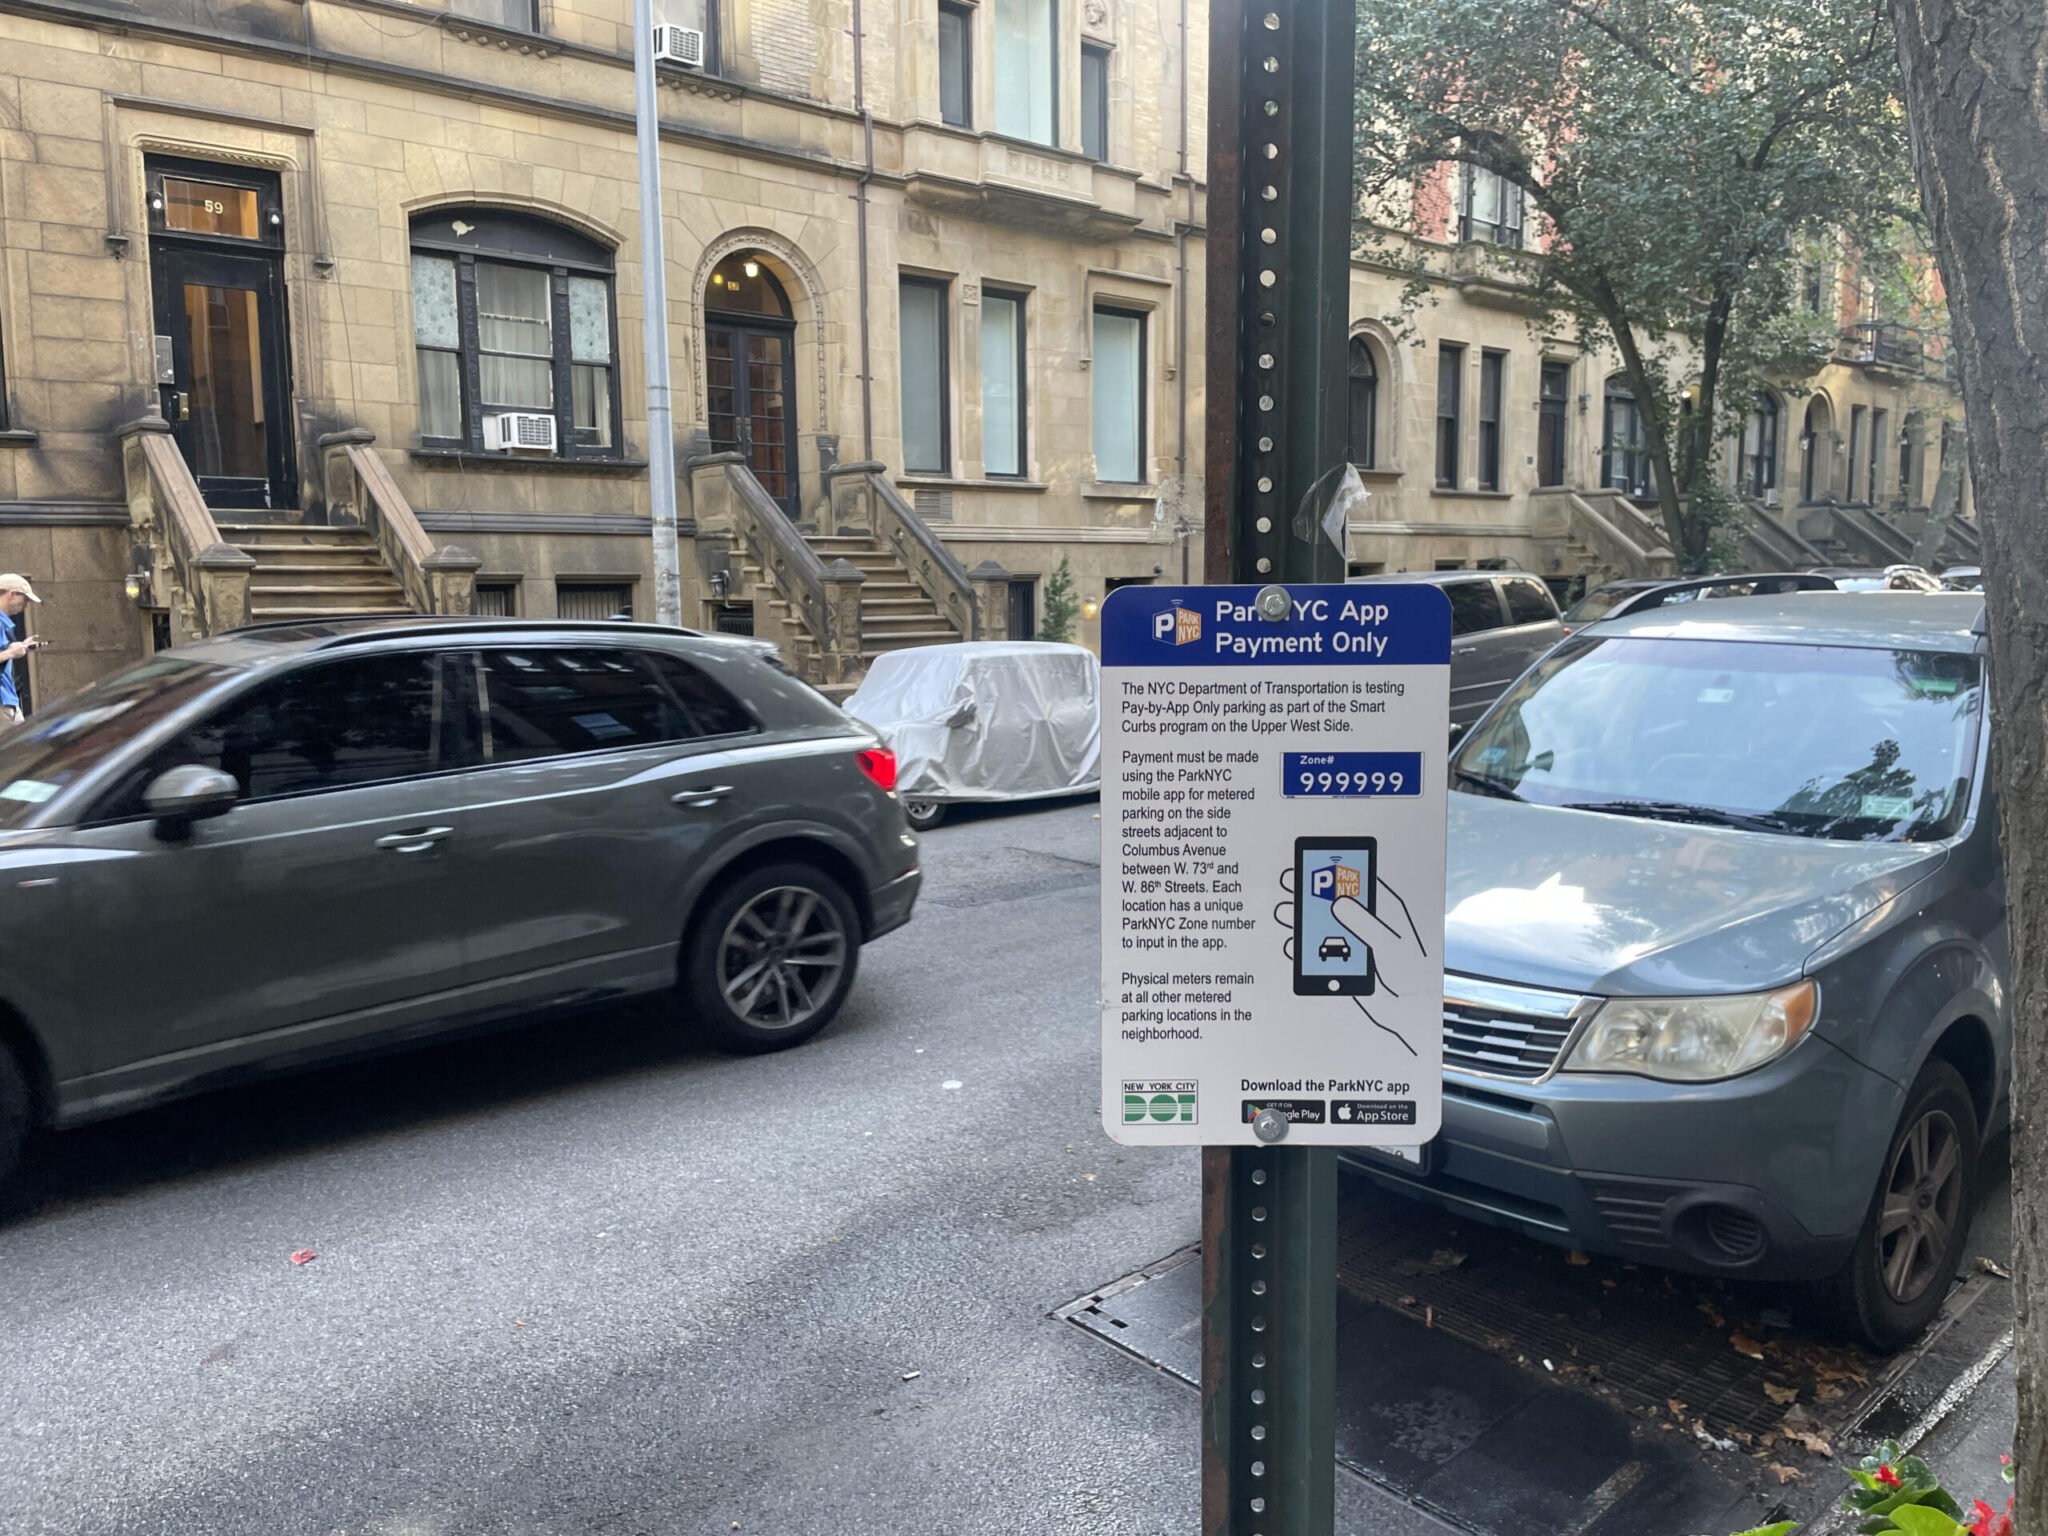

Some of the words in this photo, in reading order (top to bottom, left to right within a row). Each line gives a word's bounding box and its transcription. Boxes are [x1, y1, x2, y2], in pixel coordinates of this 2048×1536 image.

[204, 199, 224, 215] 59
[1178, 611, 1200, 625] PARK
[1216, 600, 1329, 622] ParYC
[1339, 600, 1389, 626] App
[1178, 625, 1200, 642] NYC
[1216, 632, 1323, 658] Payment
[1332, 631, 1388, 657] Only
[1121, 682, 1144, 695] The
[1148, 682, 1175, 695] NYC
[1179, 682, 1247, 697] Department
[1250, 681, 1262, 694] of
[1264, 681, 1349, 697] Transportation
[1352, 684, 1362, 694] is
[1365, 681, 1404, 697] testing
[1122, 701, 1189, 717] Pay-by-App
[1193, 700, 1220, 716] Only
[1223, 700, 1266, 716] parking
[1269, 703, 1284, 713] as
[1287, 701, 1310, 716] part
[1313, 700, 1325, 713] of
[1328, 700, 1346, 713] the
[1350, 700, 1385, 713] Smart
[1121, 719, 1156, 733] Curbs
[1160, 722, 1208, 736] program
[1211, 722, 1226, 732] on
[1229, 719, 1248, 732] the
[1251, 719, 1287, 735] Upper
[1290, 719, 1320, 732] West
[1324, 719, 1353, 732] Side.
[1122, 750, 1173, 766] Payment
[1176, 751, 1205, 763] must
[1208, 750, 1223, 763] be
[1226, 750, 1259, 763] made
[1300, 755, 1334, 764] Zone#
[1122, 769, 1153, 785] using
[1156, 769, 1175, 782] the
[1178, 768, 1232, 782] ParkNYC
[1300, 772, 1403, 792] 999999
[1122, 788, 1160, 800] mobile
[1163, 790, 1185, 803] app
[1188, 787, 1204, 800] for
[1207, 787, 1255, 800] metered
[1122, 806, 1164, 822] parking
[1167, 809, 1182, 819] on
[1185, 806, 1204, 819] the
[1207, 806, 1231, 819] side
[1122, 826, 1161, 838] streets
[1164, 825, 1213, 841] adjacent
[1216, 826, 1227, 837] to
[1122, 843, 1180, 856] Columbus
[1182, 843, 1226, 856] Avenue
[1122, 862, 1170, 875] between
[1173, 862, 1189, 874] W.
[1217, 862, 1239, 874] and
[1337, 867, 1359, 882] PARK
[1122, 880, 1136, 893] W.
[1164, 880, 1208, 893] Streets.
[1212, 880, 1242, 893] Each
[1337, 882, 1360, 897] NYC
[1122, 899, 1166, 912] location
[1170, 899, 1191, 911] has
[1194, 901, 1201, 911] a
[1204, 898, 1243, 914] unique
[1122, 917, 1175, 930] ParkNYC
[1178, 917, 1208, 930] Zone
[1212, 917, 1256, 930] number
[1122, 936, 1133, 948] to
[1136, 935, 1164, 951] input
[1167, 935, 1177, 948] in
[1181, 935, 1199, 948] the
[1202, 938, 1227, 951] app.
[1122, 972, 1169, 988] Physical
[1172, 973, 1212, 985] meters
[1215, 972, 1254, 984] remain
[1121, 991, 1133, 1003] at
[1135, 990, 1148, 1003] all
[1152, 990, 1182, 1003] other
[1184, 990, 1231, 1003] metered
[1122, 1009, 1163, 1024] parking
[1167, 1009, 1217, 1021] locations
[1220, 1008, 1231, 1021] in
[1234, 1009, 1252, 1021] the
[1122, 1027, 1203, 1043] neighborhood.
[1124, 1083, 1144, 1091] NEW
[1149, 1082, 1172, 1091] YORK
[1175, 1082, 1195, 1090] CITY
[1241, 1079, 1302, 1091] Download
[1305, 1079, 1325, 1091] the
[1328, 1079, 1383, 1092] ParkNYC
[1387, 1083, 1410, 1095] app
[1124, 1094, 1196, 1122] DOT
[1301, 1109, 1320, 1121] Play
[1357, 1110, 1379, 1122] App
[1381, 1111, 1408, 1120] Store
